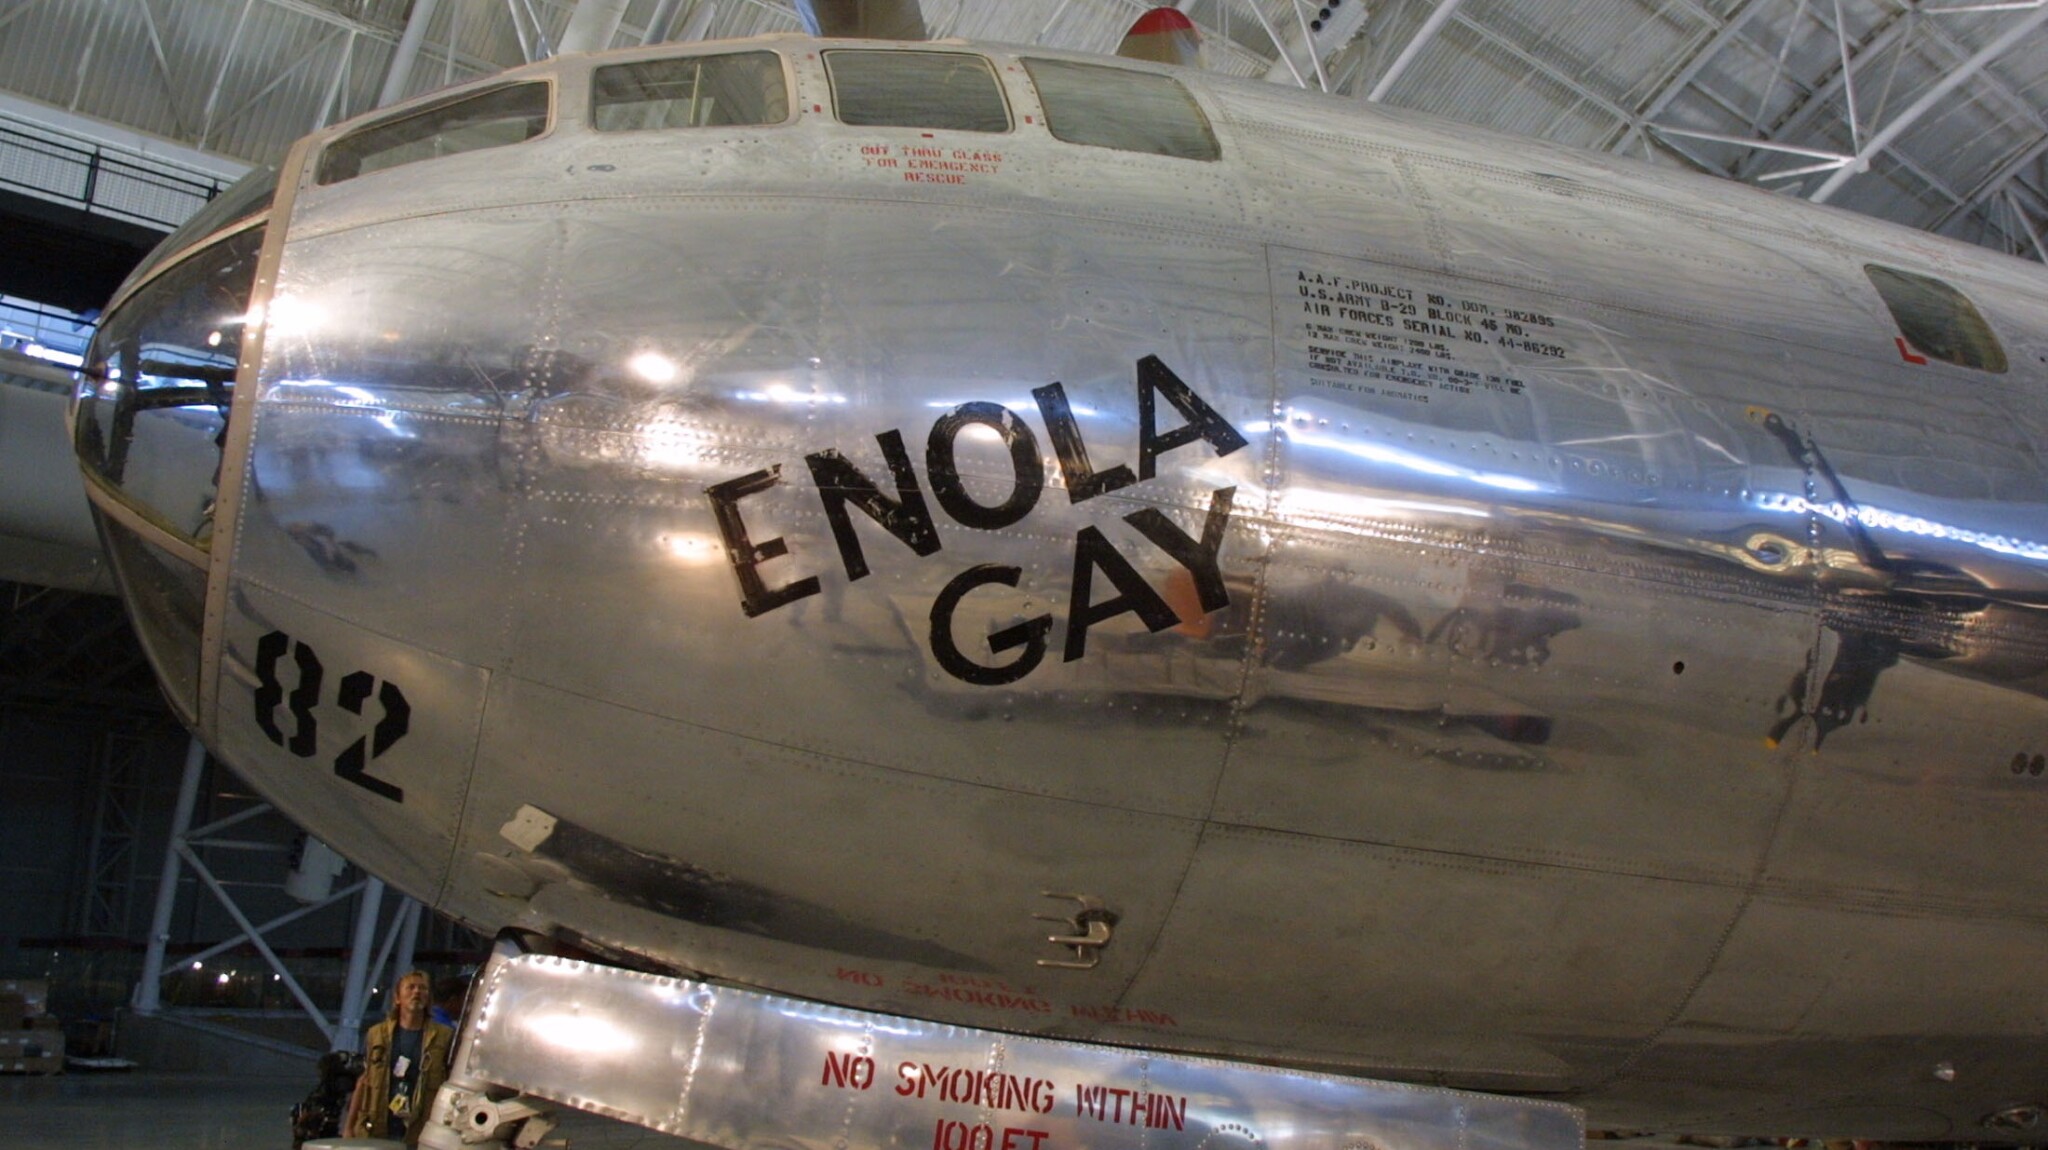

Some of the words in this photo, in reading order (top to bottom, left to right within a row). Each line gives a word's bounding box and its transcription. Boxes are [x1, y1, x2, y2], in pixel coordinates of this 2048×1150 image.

[861, 145, 890, 156] CUT
[902, 144, 943, 158] THRU
[952, 150, 1003, 163] GLASS
[863, 157, 898, 168] FOR
[908, 159, 1000, 174] EMERGENCY
[904, 172, 966, 185] RESCUE
[1427, 292, 1453, 308] NO.
[1303, 301, 1331, 318] AIR
[1339, 307, 1395, 328] FORCES
[1402, 318, 1456, 339] SERIAL
[1464, 330, 1489, 345] NO.
[1498, 336, 1567, 359] 44-86292
[1380, 301, 1417, 317] B-29
[1428, 308, 1473, 326] BLOCK
[1480, 318, 1498, 332] 45
[1505, 322, 1531, 338] MO.
[1365, 332, 1398, 342] WEIGHT
[704, 353, 1249, 617] ENOLA
[929, 486, 1237, 686] GAY
[254, 630, 411, 803] 82
[821, 1051, 875, 1090] NO
[894, 1061, 1054, 1114] SMOKING
[1077, 1083, 1187, 1131] WITHIN
[933, 1118, 993, 1150] 100
[1001, 1127, 1049, 1150] FT
